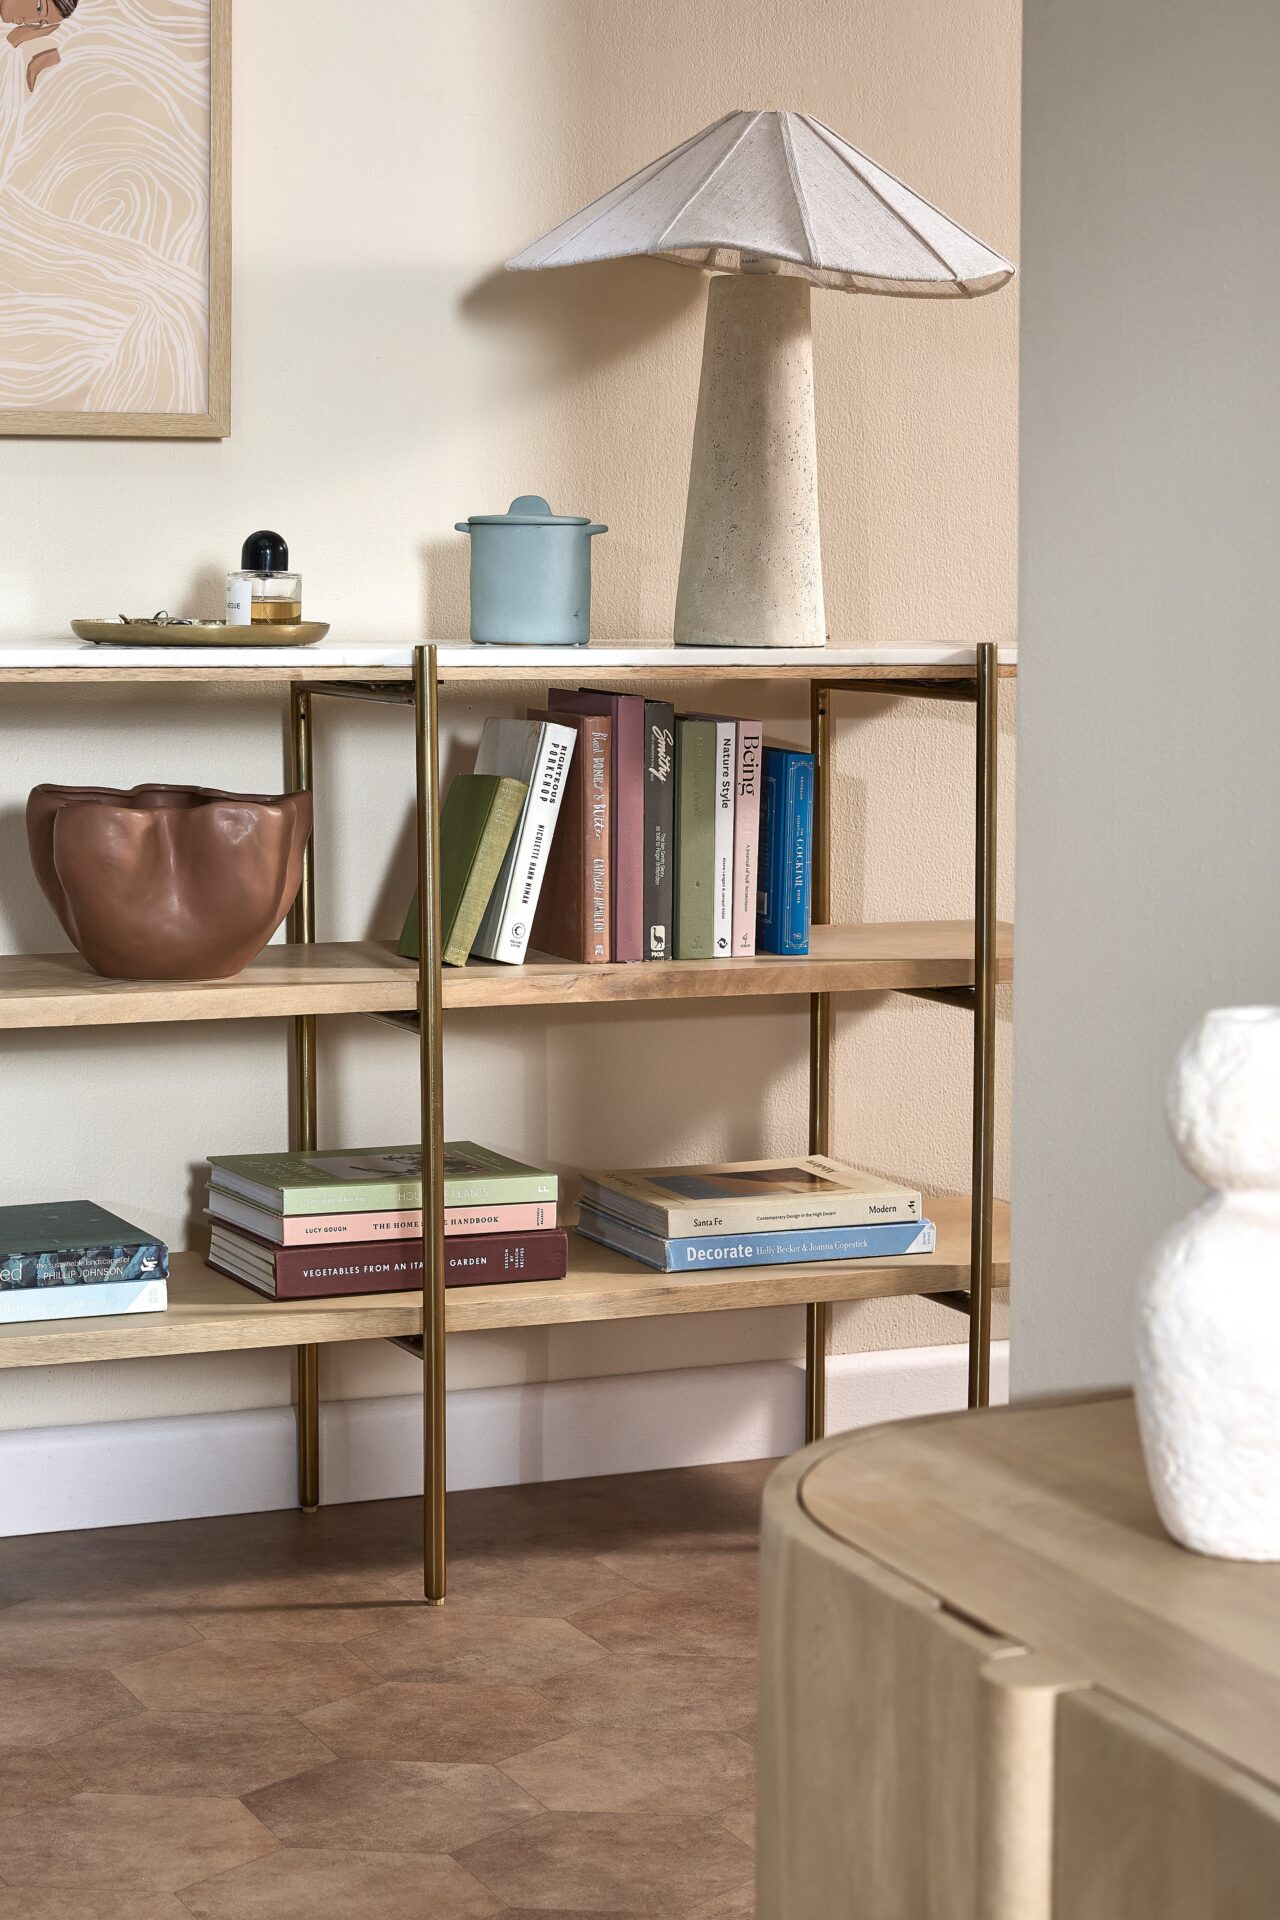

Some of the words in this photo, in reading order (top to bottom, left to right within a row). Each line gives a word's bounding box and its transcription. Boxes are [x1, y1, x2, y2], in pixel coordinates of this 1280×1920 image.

[648, 726, 674, 784] Smithy
[722, 738, 731, 777] Nature
[738, 736, 759, 796] Being
[540, 742, 560, 802] PORKCHOP
[549, 745, 568, 804] RIGHTEOUS
[720, 781, 730, 808] Style
[531, 824, 545, 860] NICOLETTE
[795, 839, 804, 888] COCKTAIL
[522, 882, 532, 904] NIMAN
[452, 1188, 489, 1198] PLANTS
[451, 1216, 499, 1225] HANDBOOK
[869, 1205, 896, 1214] Modern
[694, 1219, 712, 1227] Santa
[687, 1244, 753, 1261] Decorate
[756, 1246, 774, 1256] Holly
[776, 1245, 800, 1254] Becker
[809, 1243, 833, 1252] Joanna
[835, 1239, 868, 1251] Copestick
[44, 1270, 76, 1280] PHILLIP
[78, 1266, 124, 1278] JOHNSON
[303, 1266, 360, 1277] VEGETABLES
[364, 1264, 390, 1273] FROM
[450, 1257, 487, 1266] GARDEN
